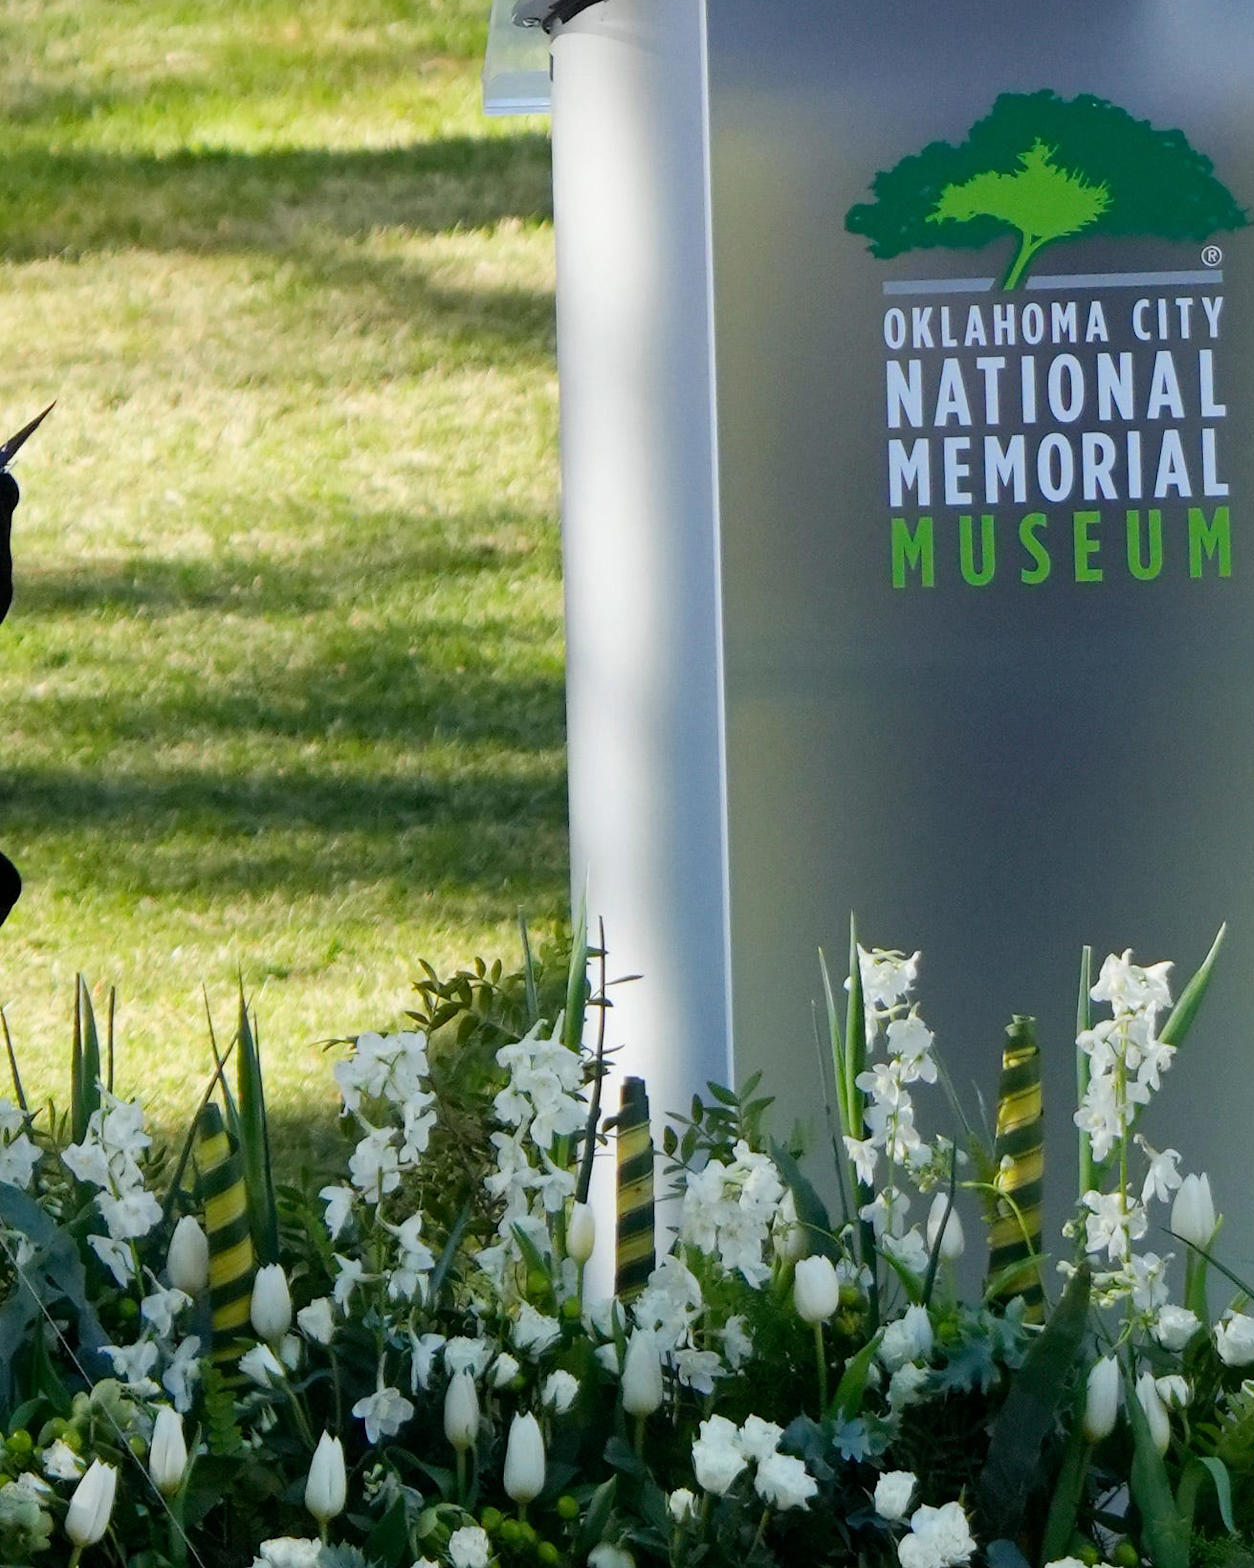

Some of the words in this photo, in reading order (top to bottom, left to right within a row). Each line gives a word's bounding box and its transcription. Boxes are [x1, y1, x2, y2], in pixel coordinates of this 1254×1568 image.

[883, 301, 1109, 349] OKLAHOMA
[1132, 296, 1224, 341] CITY
[886, 349, 1227, 428] NATIONAL
[888, 427, 1230, 507] MEMORIAL
[892, 507, 1233, 589] MUSEUM
